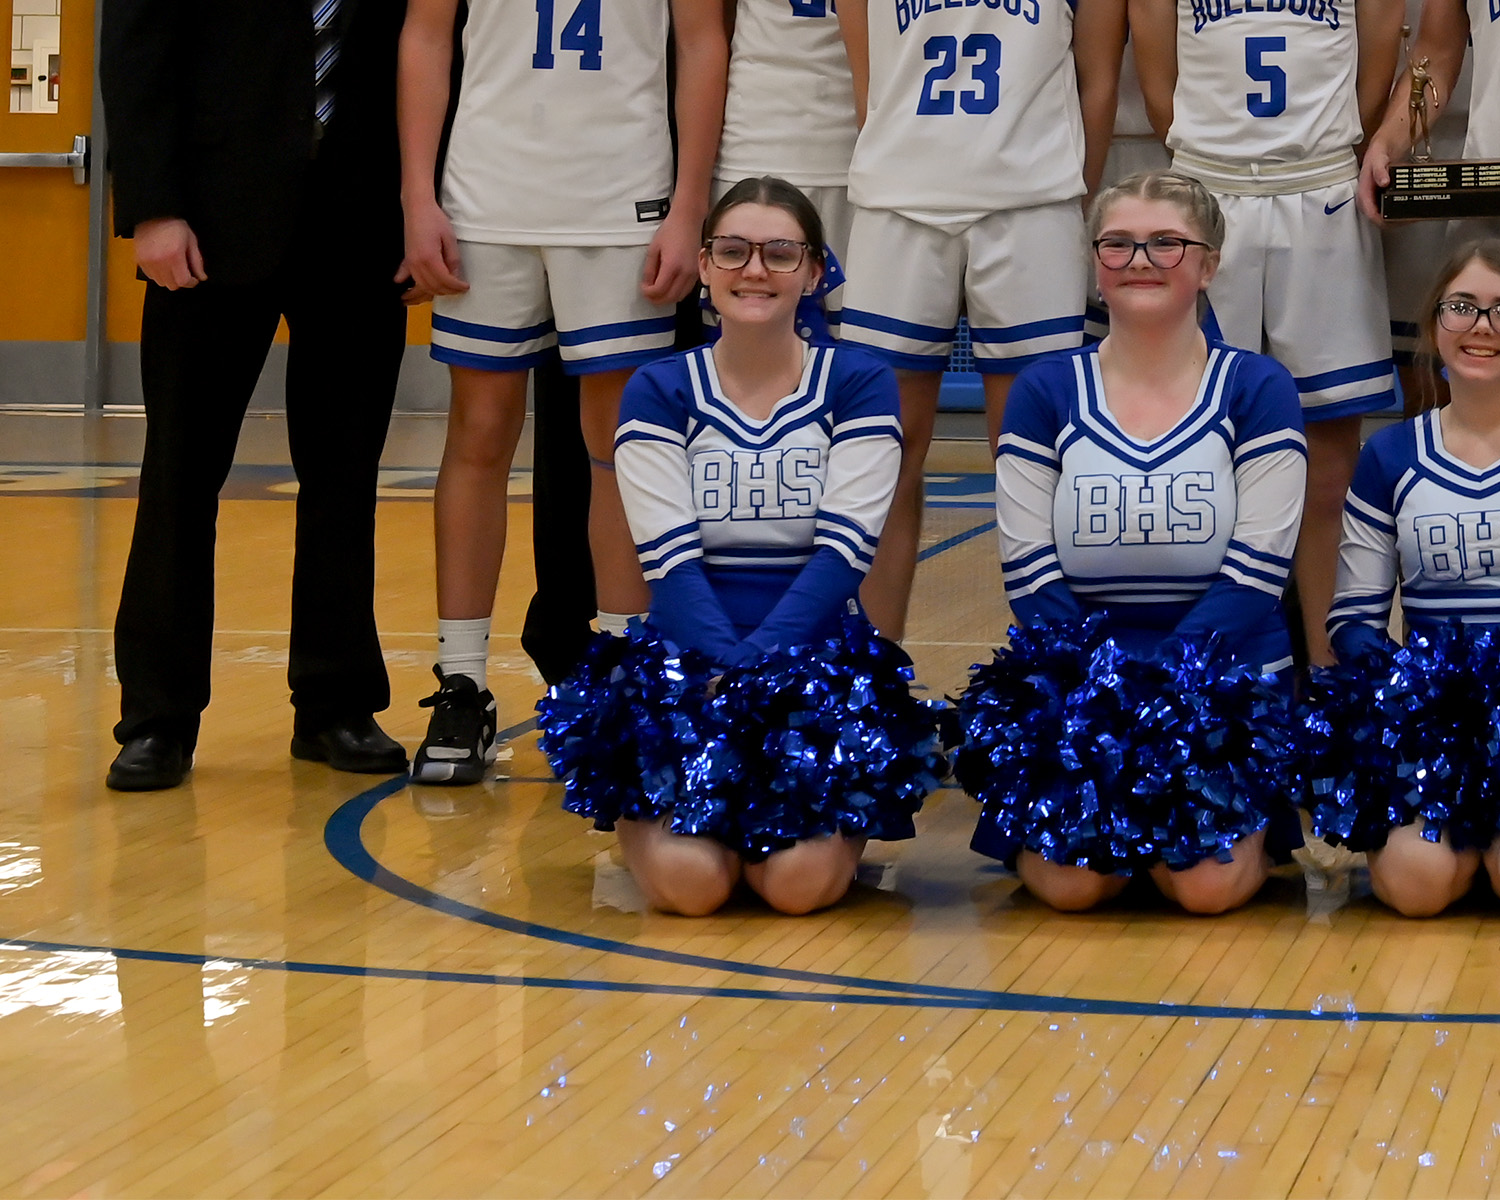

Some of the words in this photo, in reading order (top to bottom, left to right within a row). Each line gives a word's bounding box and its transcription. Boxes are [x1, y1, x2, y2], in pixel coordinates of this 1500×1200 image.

[916, 33, 1001, 116] 23
[1245, 36, 1286, 117] 5
[691, 448, 822, 521] BHS
[1073, 471, 1217, 546] BHS
